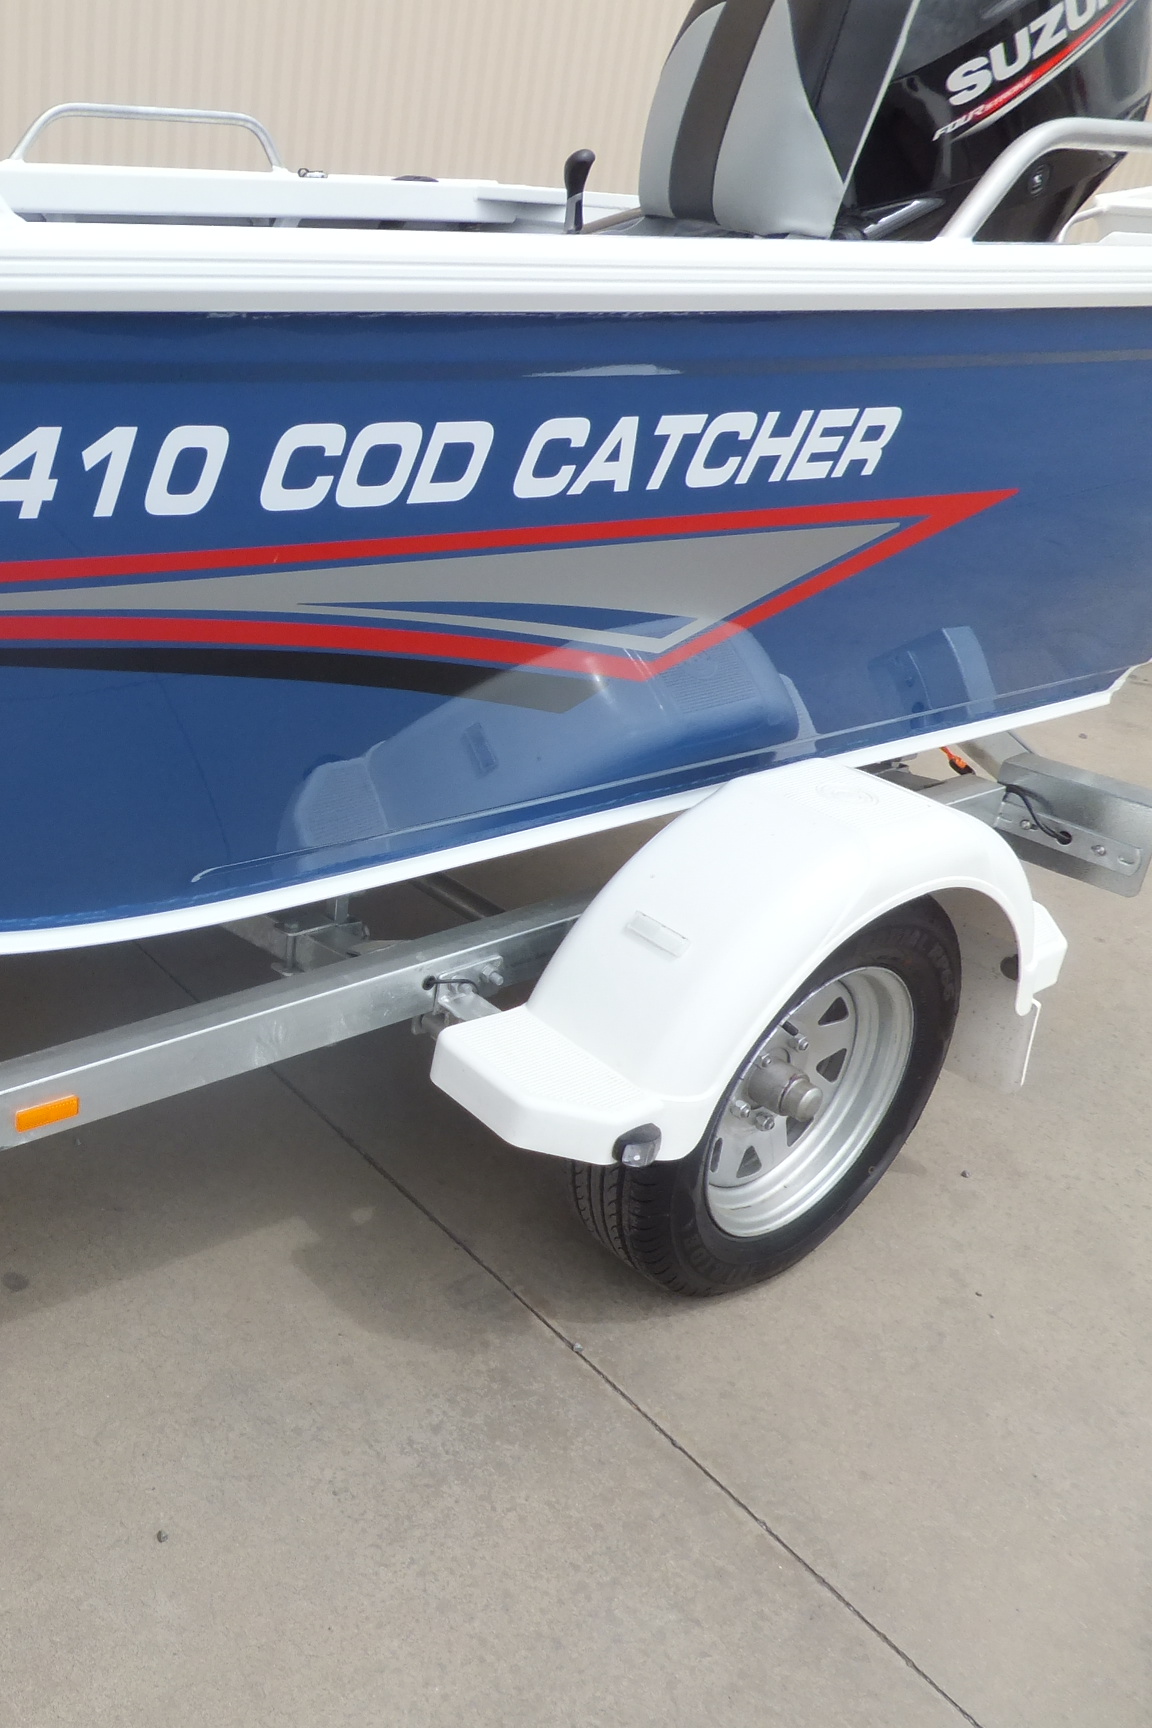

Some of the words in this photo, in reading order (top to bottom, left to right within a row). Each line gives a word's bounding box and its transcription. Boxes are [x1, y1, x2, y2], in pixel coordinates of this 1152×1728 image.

[946, 0, 1109, 106] SUZU
[259, 420, 495, 512] COD
[512, 405, 903, 499] CATCHER
